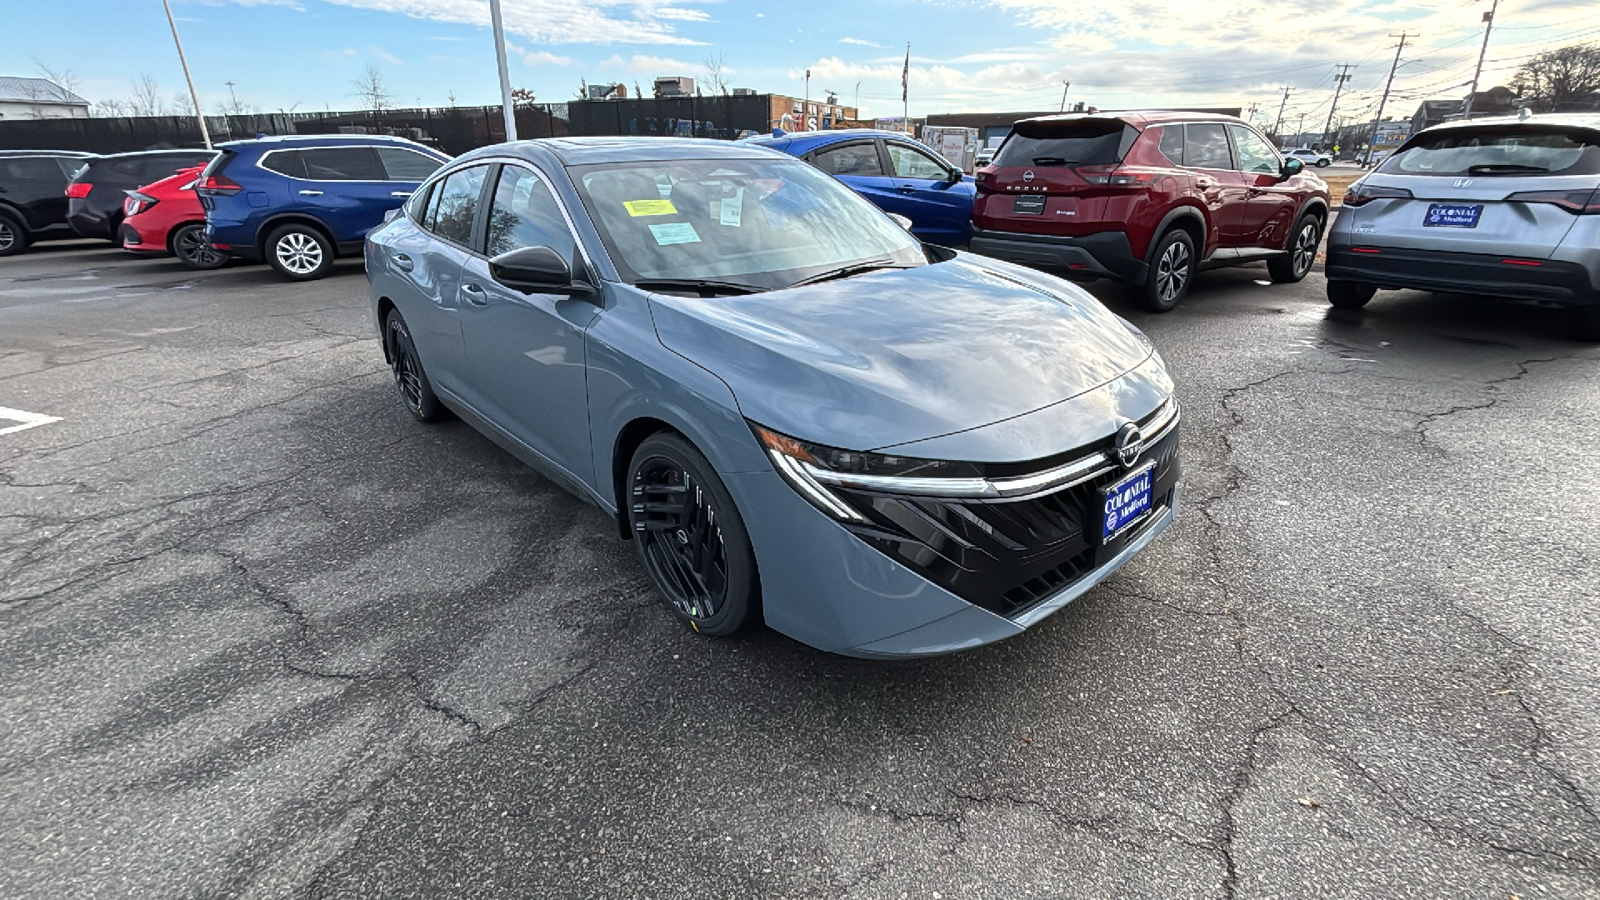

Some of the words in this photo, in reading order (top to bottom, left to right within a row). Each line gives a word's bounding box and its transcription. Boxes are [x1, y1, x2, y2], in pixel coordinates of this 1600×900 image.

[1430, 208, 1477, 216] COLONIAL
[1105, 477, 1150, 514] COLONIAL
[1120, 493, 1148, 520] Medford
